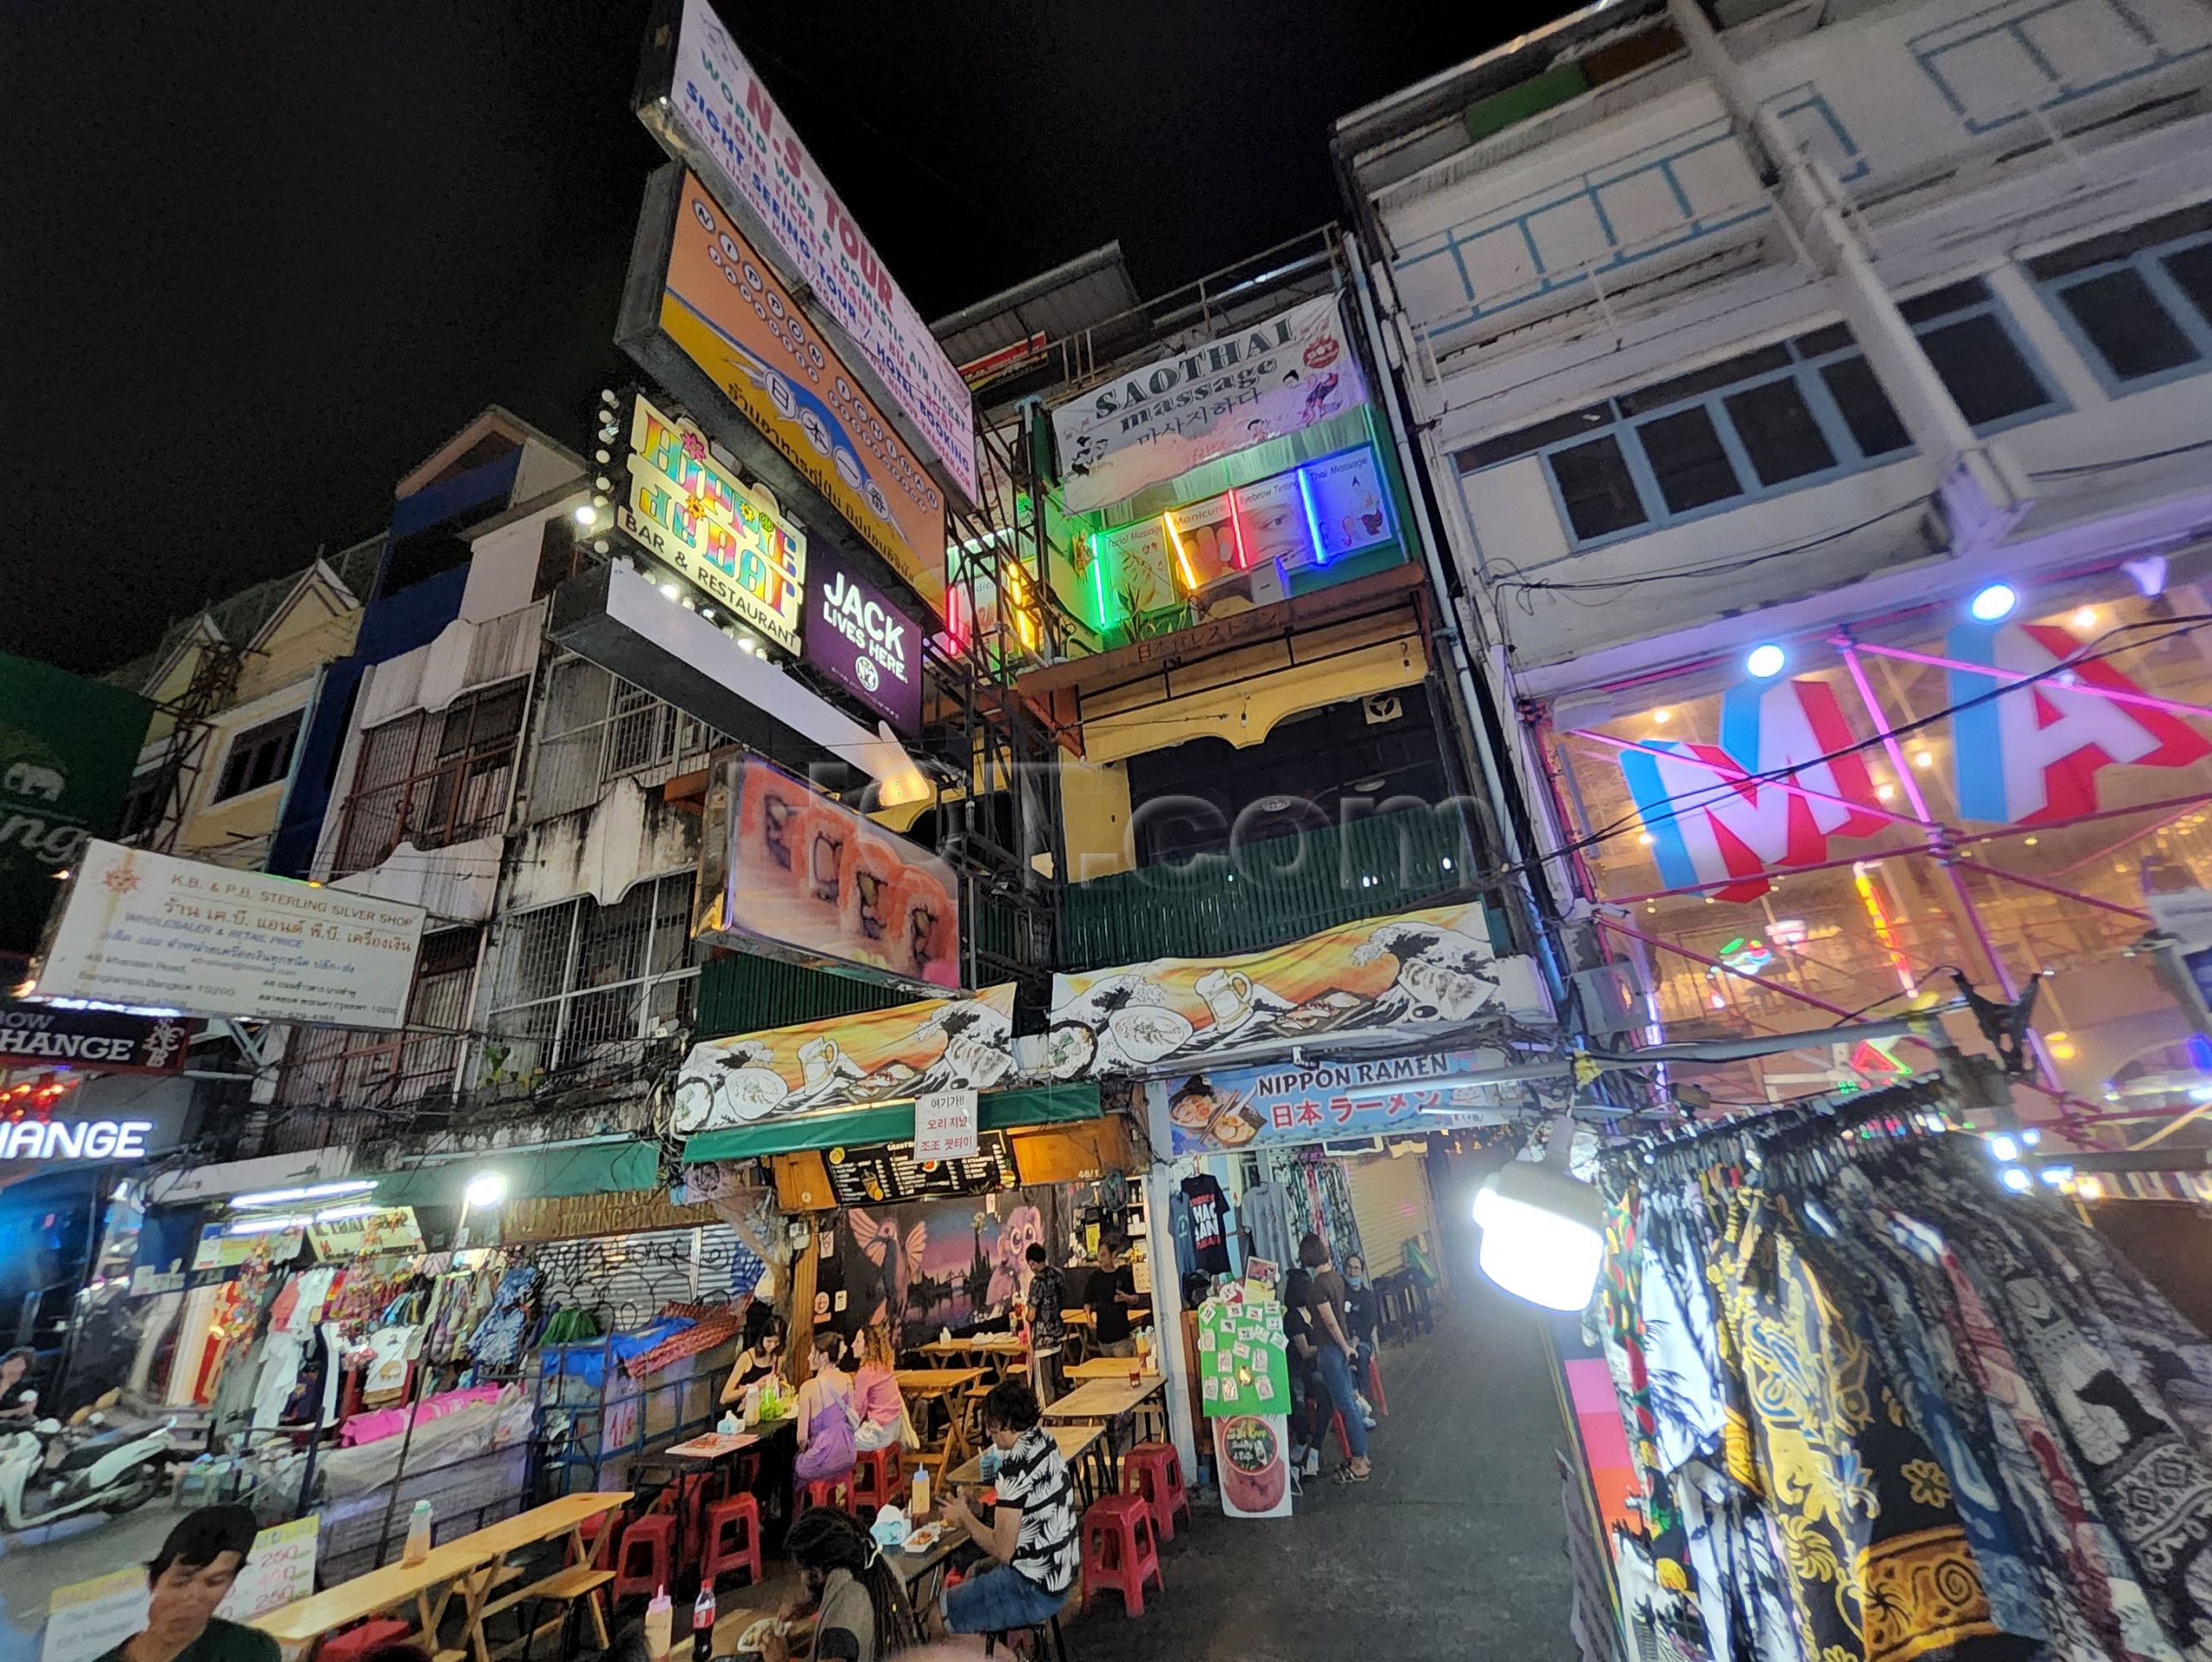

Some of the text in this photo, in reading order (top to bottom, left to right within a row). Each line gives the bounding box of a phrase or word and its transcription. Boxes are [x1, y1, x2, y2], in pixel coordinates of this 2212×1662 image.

[746, 75, 893, 318] N.S. TOUR
[685, 76, 745, 171] SIGHT
[751, 169, 810, 264] SEEING
[817, 259, 856, 326] TOUR
[876, 338, 914, 404] HOTEL
[918, 394, 969, 478] BOOKING
[700, 48, 767, 158] WORLD
[773, 156, 815, 227] WIDE
[821, 223, 832, 252] &
[840, 249, 904, 354] DOMESTIC
[909, 346, 929, 387] AIR
[931, 376, 965, 436] TICKET
[722, 105, 766, 179] JOIN
[773, 178, 823, 260] TICKET
[830, 256, 872, 327] TRAIN
[888, 336, 911, 381] BUS
[692, 194, 937, 514] NIPPON ICHIBAN
[1096, 314, 1294, 420] SAOTHAI
[1121, 356, 1279, 431] massage
[768, 364, 888, 525] 日本一番
[1310, 456, 1369, 482] Thai Massage
[1173, 504, 1227, 526] Manicure
[1239, 487, 1272, 505] Eyebrow
[624, 515, 797, 647] BAR & RESTAURANT
[702, 519, 795, 616] BAR
[1108, 534, 1129, 549] Facial
[823, 571, 904, 660] JACK
[823, 601, 908, 685] LIVES HERE.
[162, 895, 203, 919] ร้าน
[170, 872, 205, 888] K.B.
[225, 883, 254, 899] P.B.
[259, 889, 327, 913] STERLING
[331, 903, 375, 921] SILVER
[378, 912, 413, 929] SHOP
[1258, 1053, 1448, 1097] NIPPON RAMEN
[1272, 1091, 1441, 1129] 日本 ラーメン
[1077, 1169, 1100, 1179] 46/1
